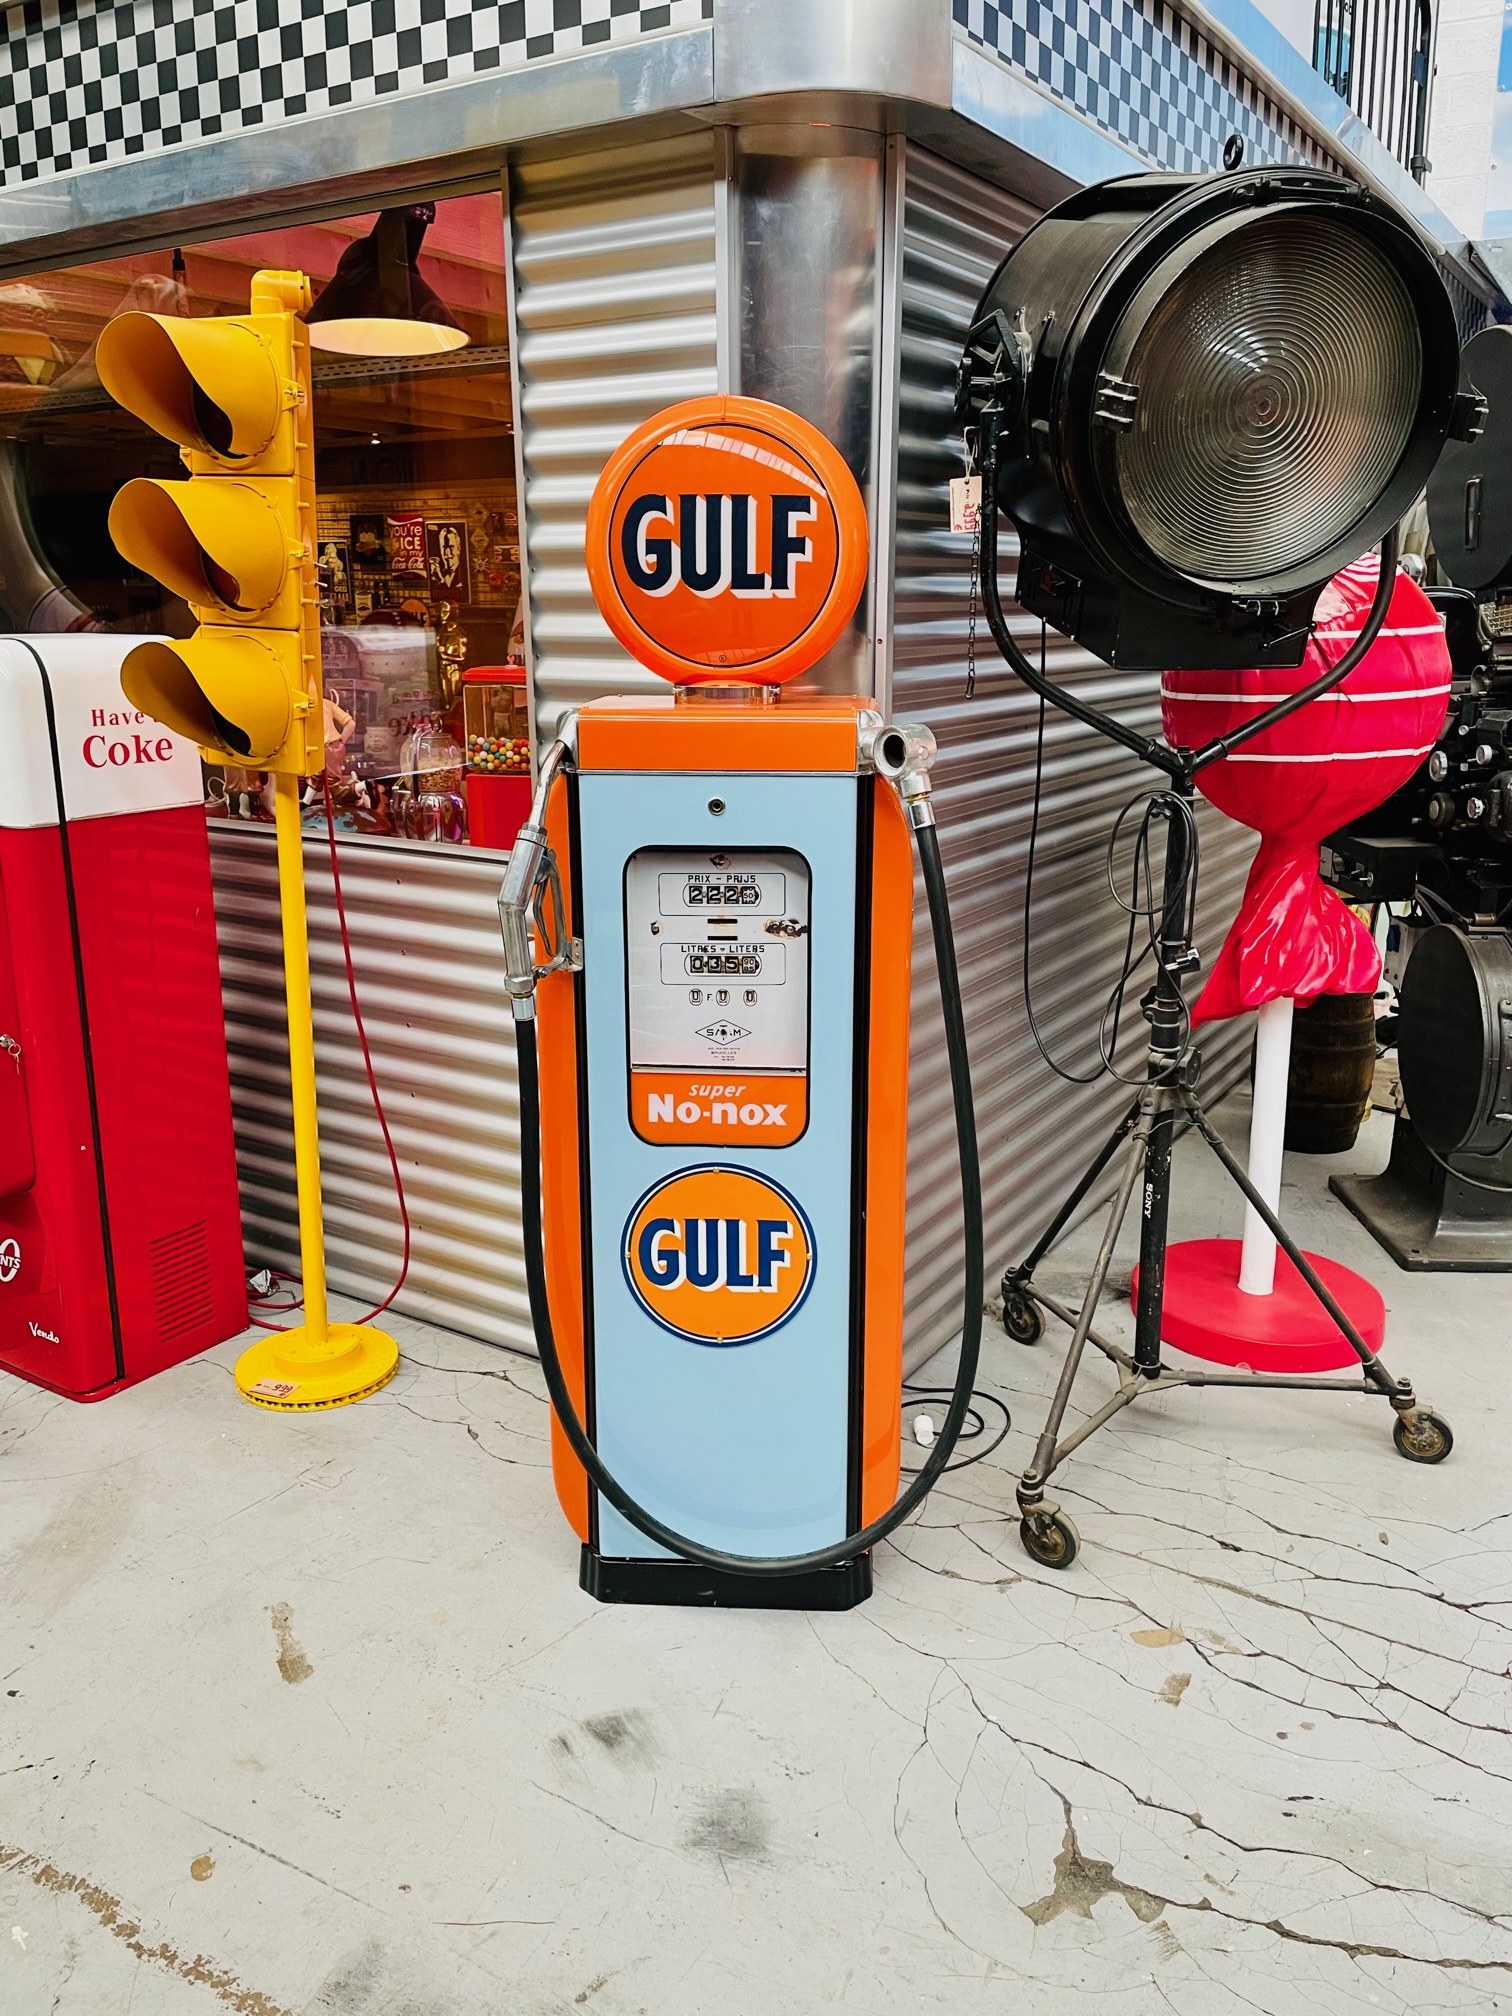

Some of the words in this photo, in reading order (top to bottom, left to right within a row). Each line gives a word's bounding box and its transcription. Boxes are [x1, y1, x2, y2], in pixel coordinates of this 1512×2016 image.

[621, 494, 818, 599] GULF
[91, 709, 145, 727] Have
[83, 734, 173, 768] Coke
[687, 874, 711, 883] PRIX
[726, 874, 756, 883] PRIJS
[681, 945, 717, 953] LITRES
[729, 945, 765, 953] LITERS
[688, 1084, 746, 1100] super
[647, 1093, 788, 1126] No-nox
[1144, 1183, 1154, 1219] SONY
[0, 1254, 21, 1270] NTS
[638, 1217, 793, 1293] GULF
[28, 1321, 60, 1344] Vendo
